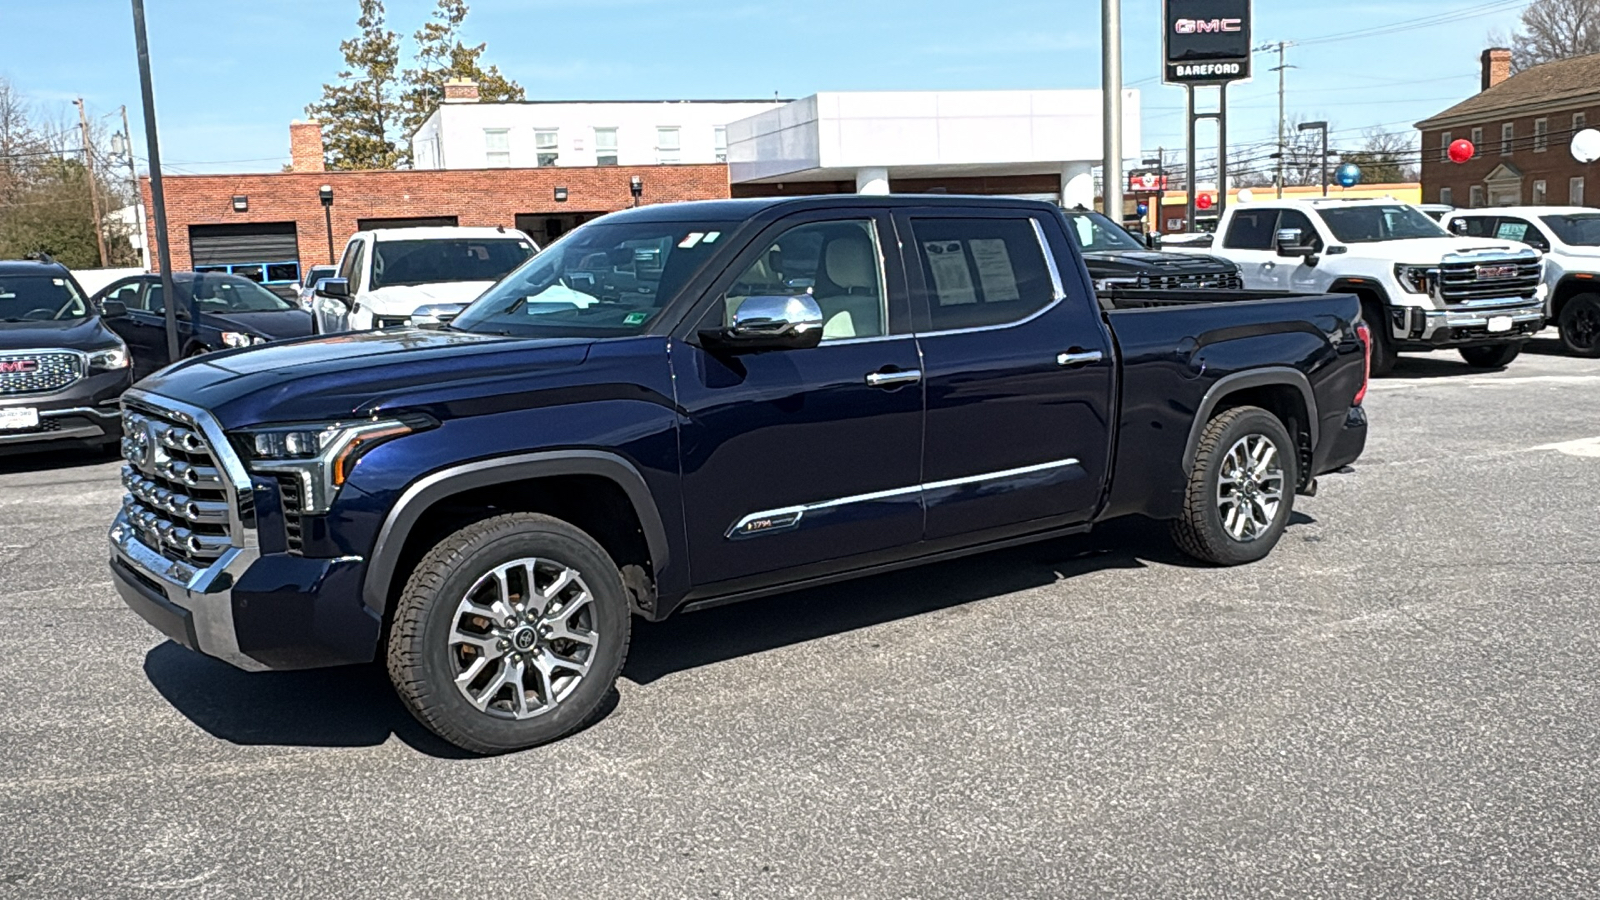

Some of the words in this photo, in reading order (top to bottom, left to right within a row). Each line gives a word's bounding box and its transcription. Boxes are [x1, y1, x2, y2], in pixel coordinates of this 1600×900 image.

[1175, 18, 1241, 34] GMC
[1176, 63, 1240, 76] BAREFORD
[0, 360, 37, 373] MC
[753, 519, 772, 529] 1794
